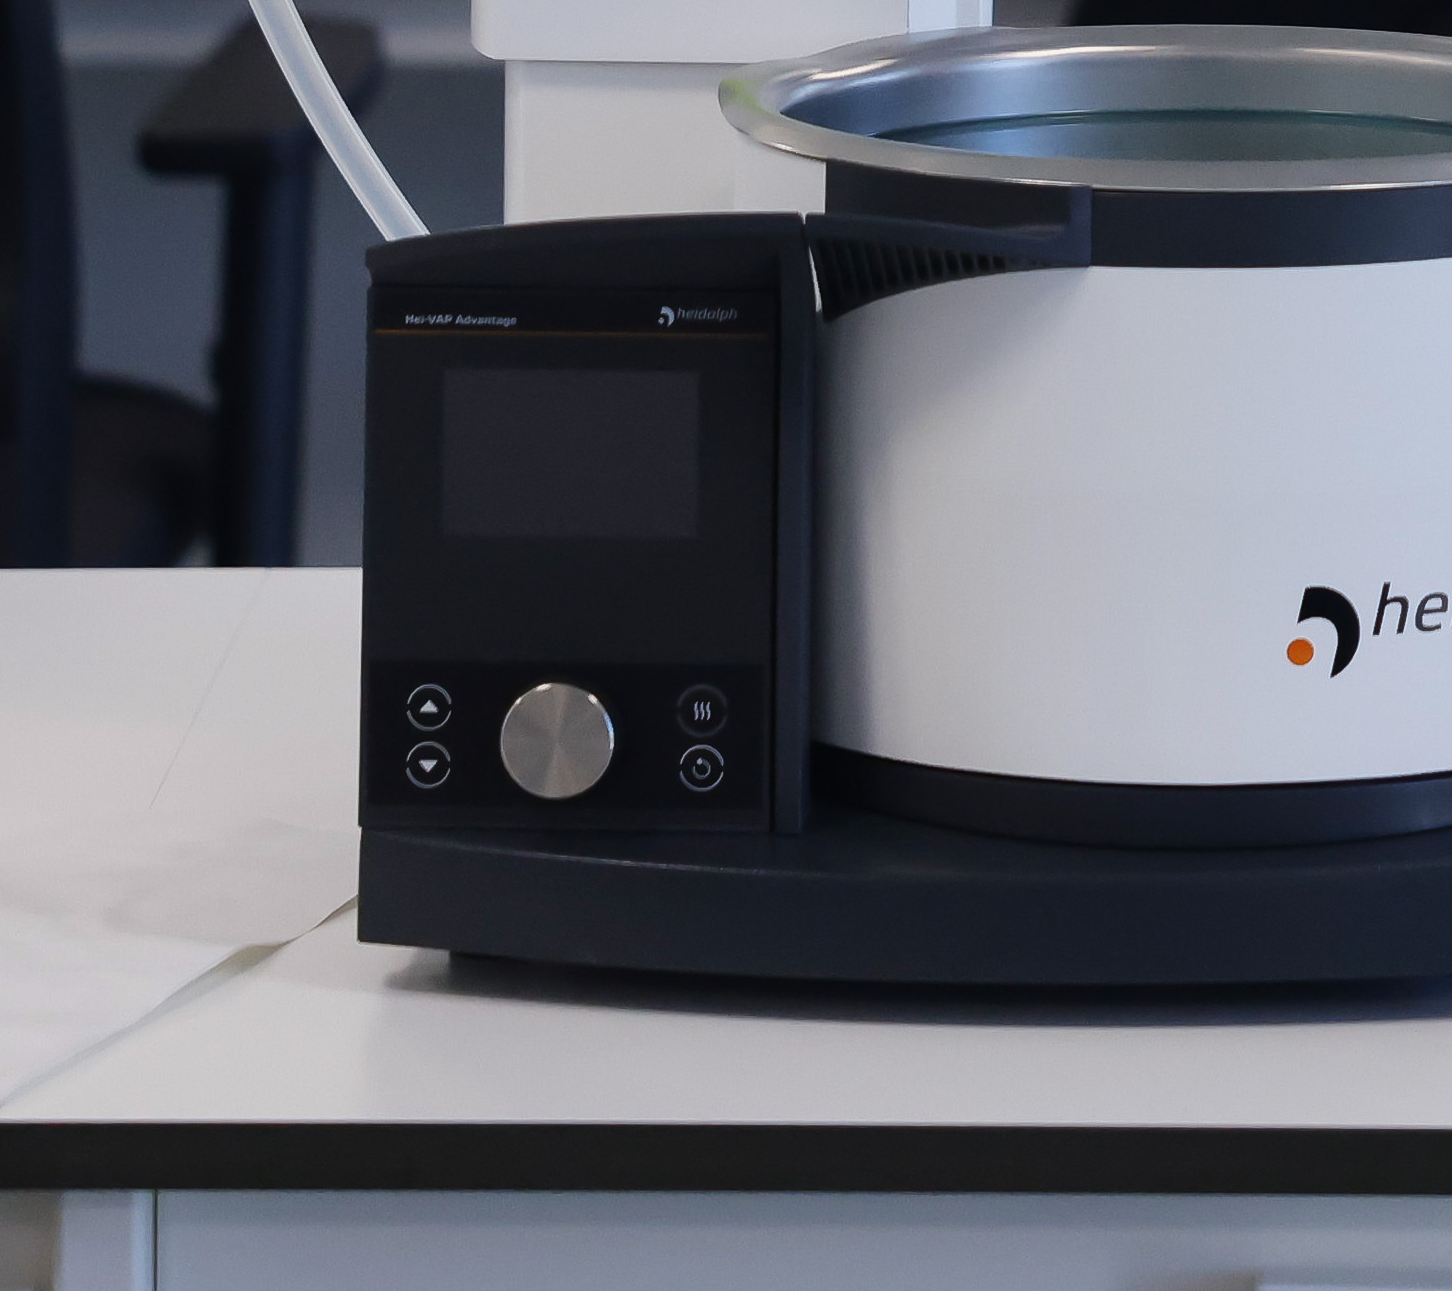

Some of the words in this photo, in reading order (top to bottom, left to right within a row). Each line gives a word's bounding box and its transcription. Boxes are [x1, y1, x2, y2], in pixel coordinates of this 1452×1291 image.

[405, 314, 453, 325] Hei-VAP
[455, 314, 517, 327] Advantage
[677, 307, 738, 322] heidolph
